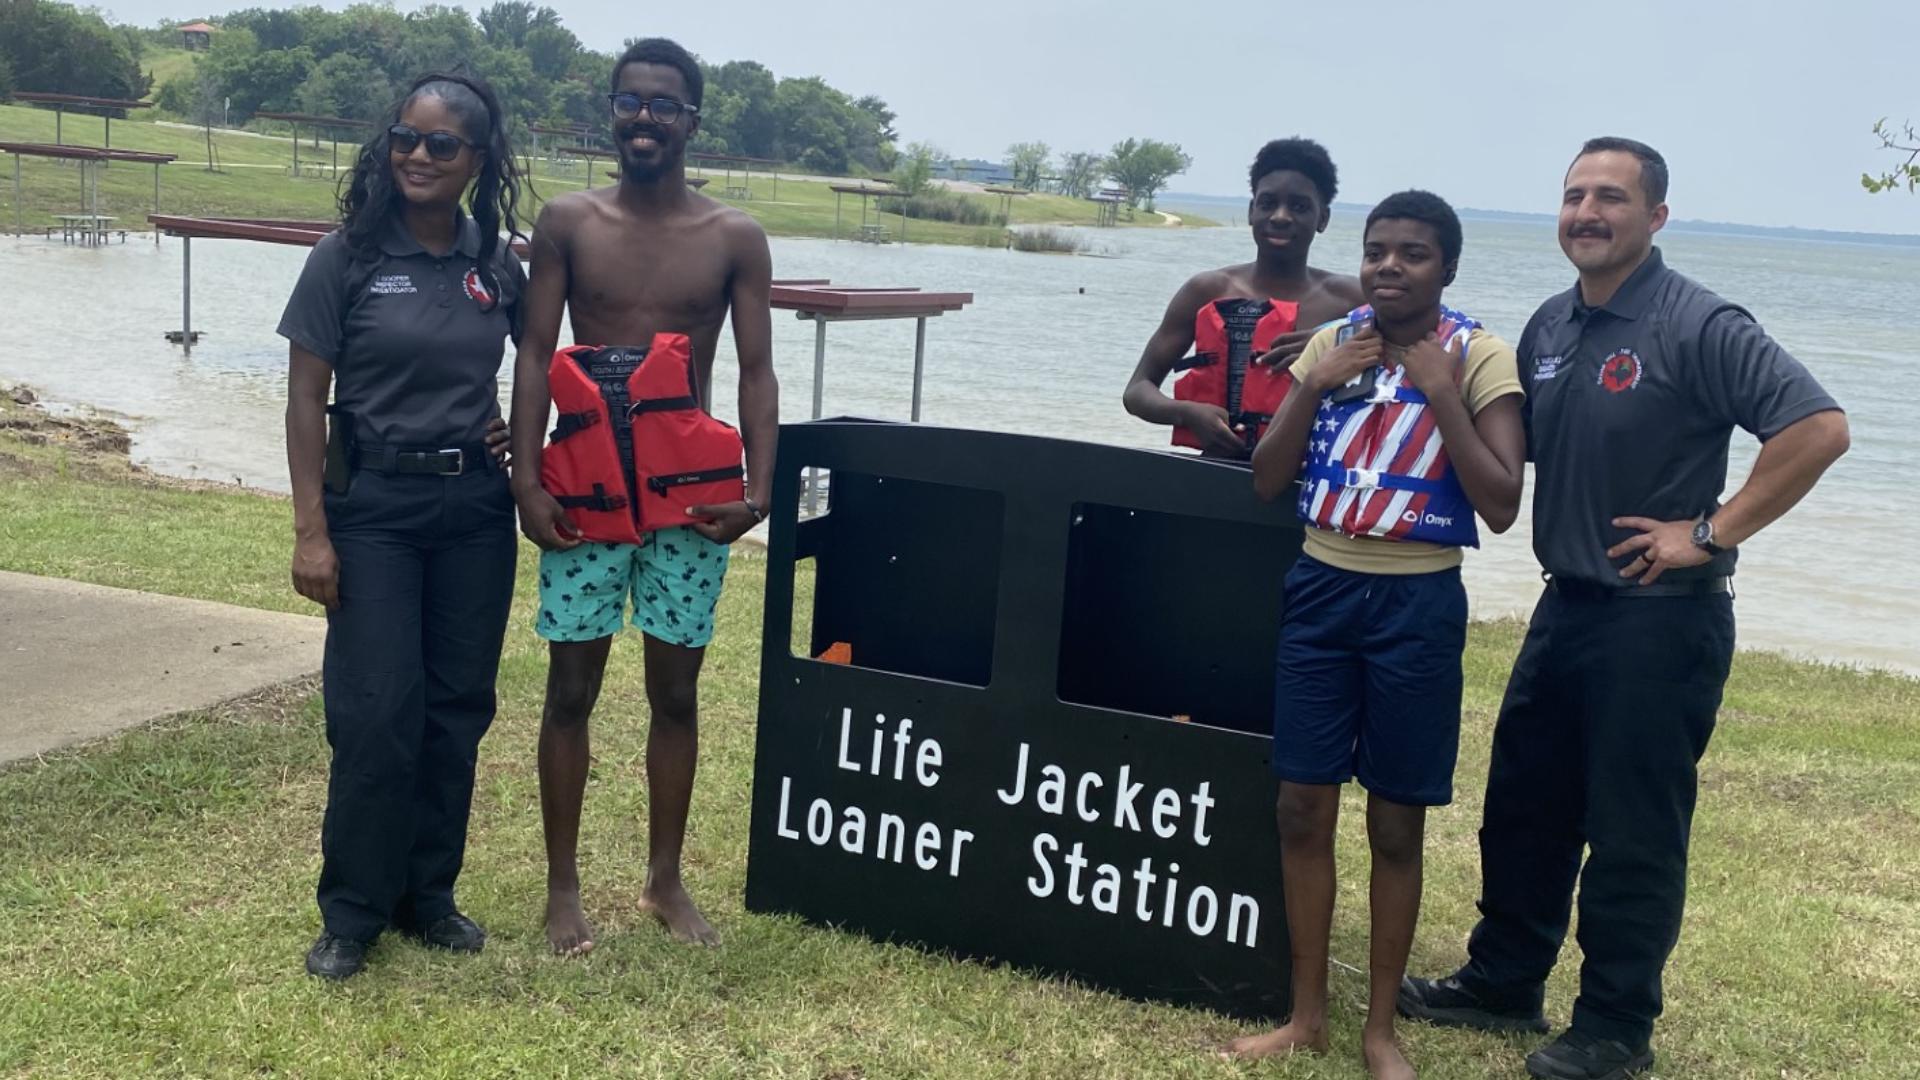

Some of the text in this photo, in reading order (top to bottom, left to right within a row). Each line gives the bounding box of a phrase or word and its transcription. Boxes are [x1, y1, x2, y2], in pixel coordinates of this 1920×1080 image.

[1425, 513, 1453, 528] Onyx
[838, 707, 1215, 847] Life Jacket
[777, 776, 1260, 948] Loaner Station
